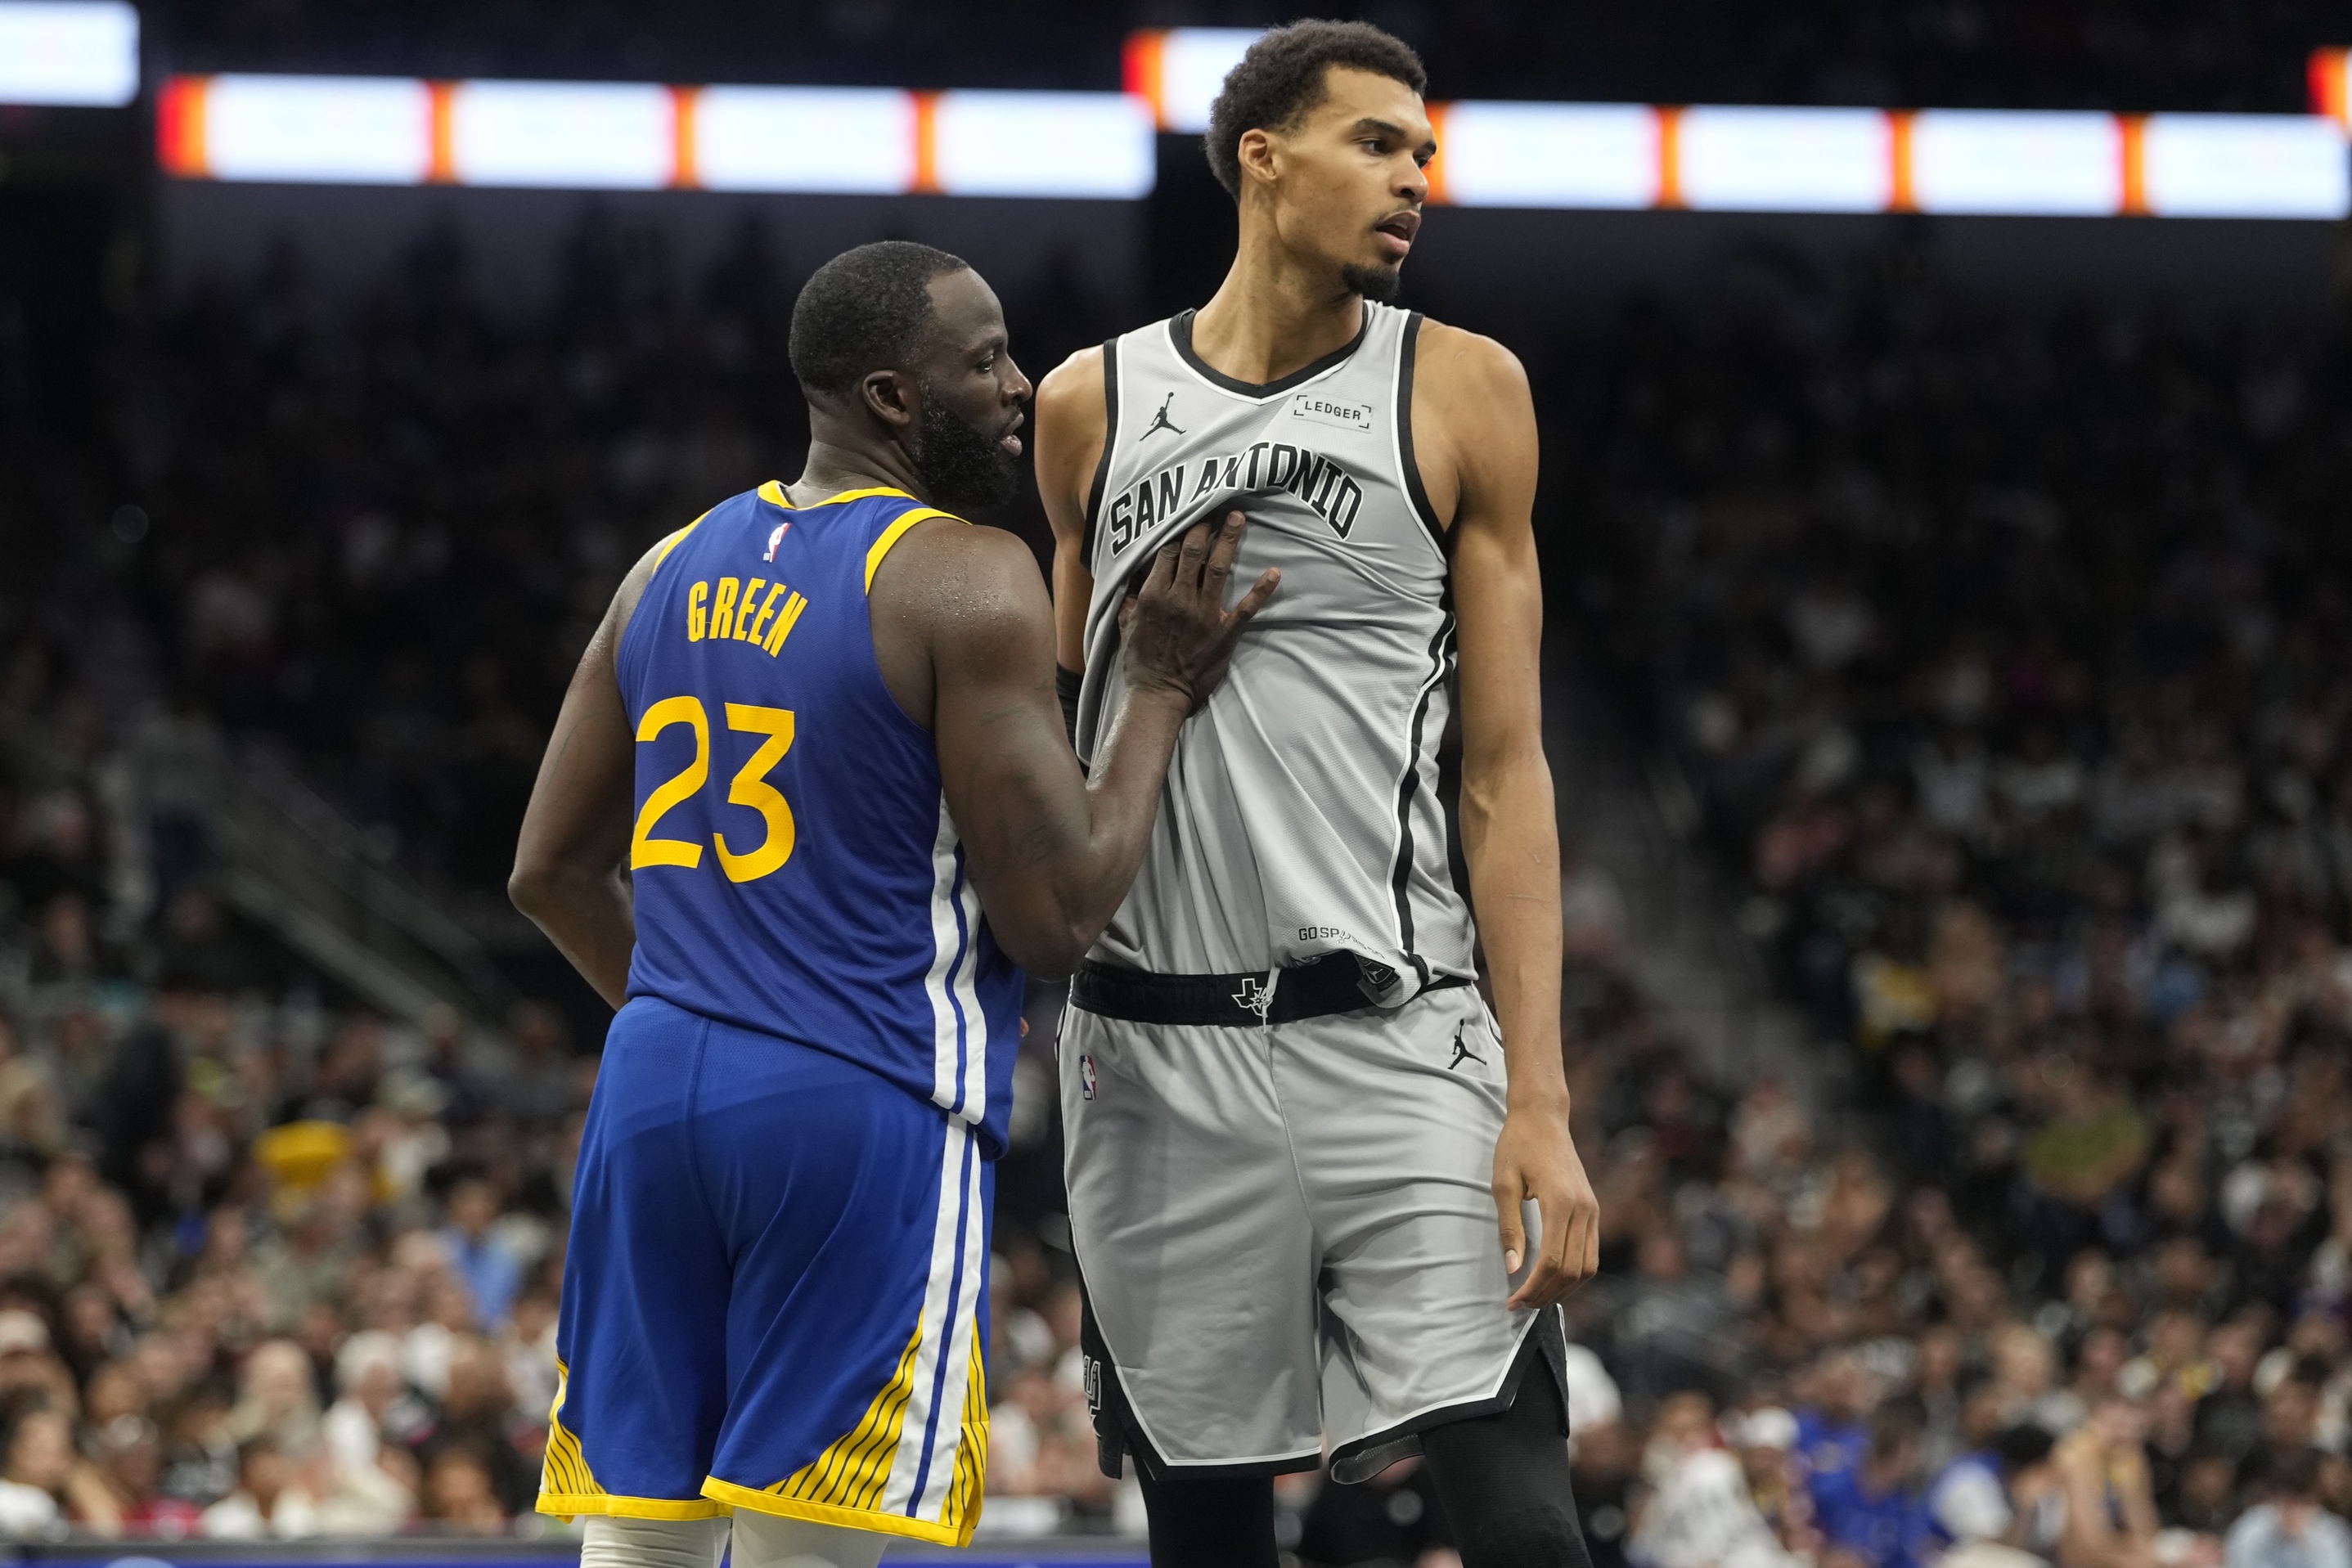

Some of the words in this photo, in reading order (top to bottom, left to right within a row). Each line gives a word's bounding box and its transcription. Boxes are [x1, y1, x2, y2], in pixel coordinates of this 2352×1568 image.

[1304, 401, 1361, 420] LEDGER
[1109, 465, 1186, 559] SAN
[1187, 440, 1364, 541] ANTONIO
[688, 577, 808, 658] GREEN
[631, 695, 795, 883] 23
